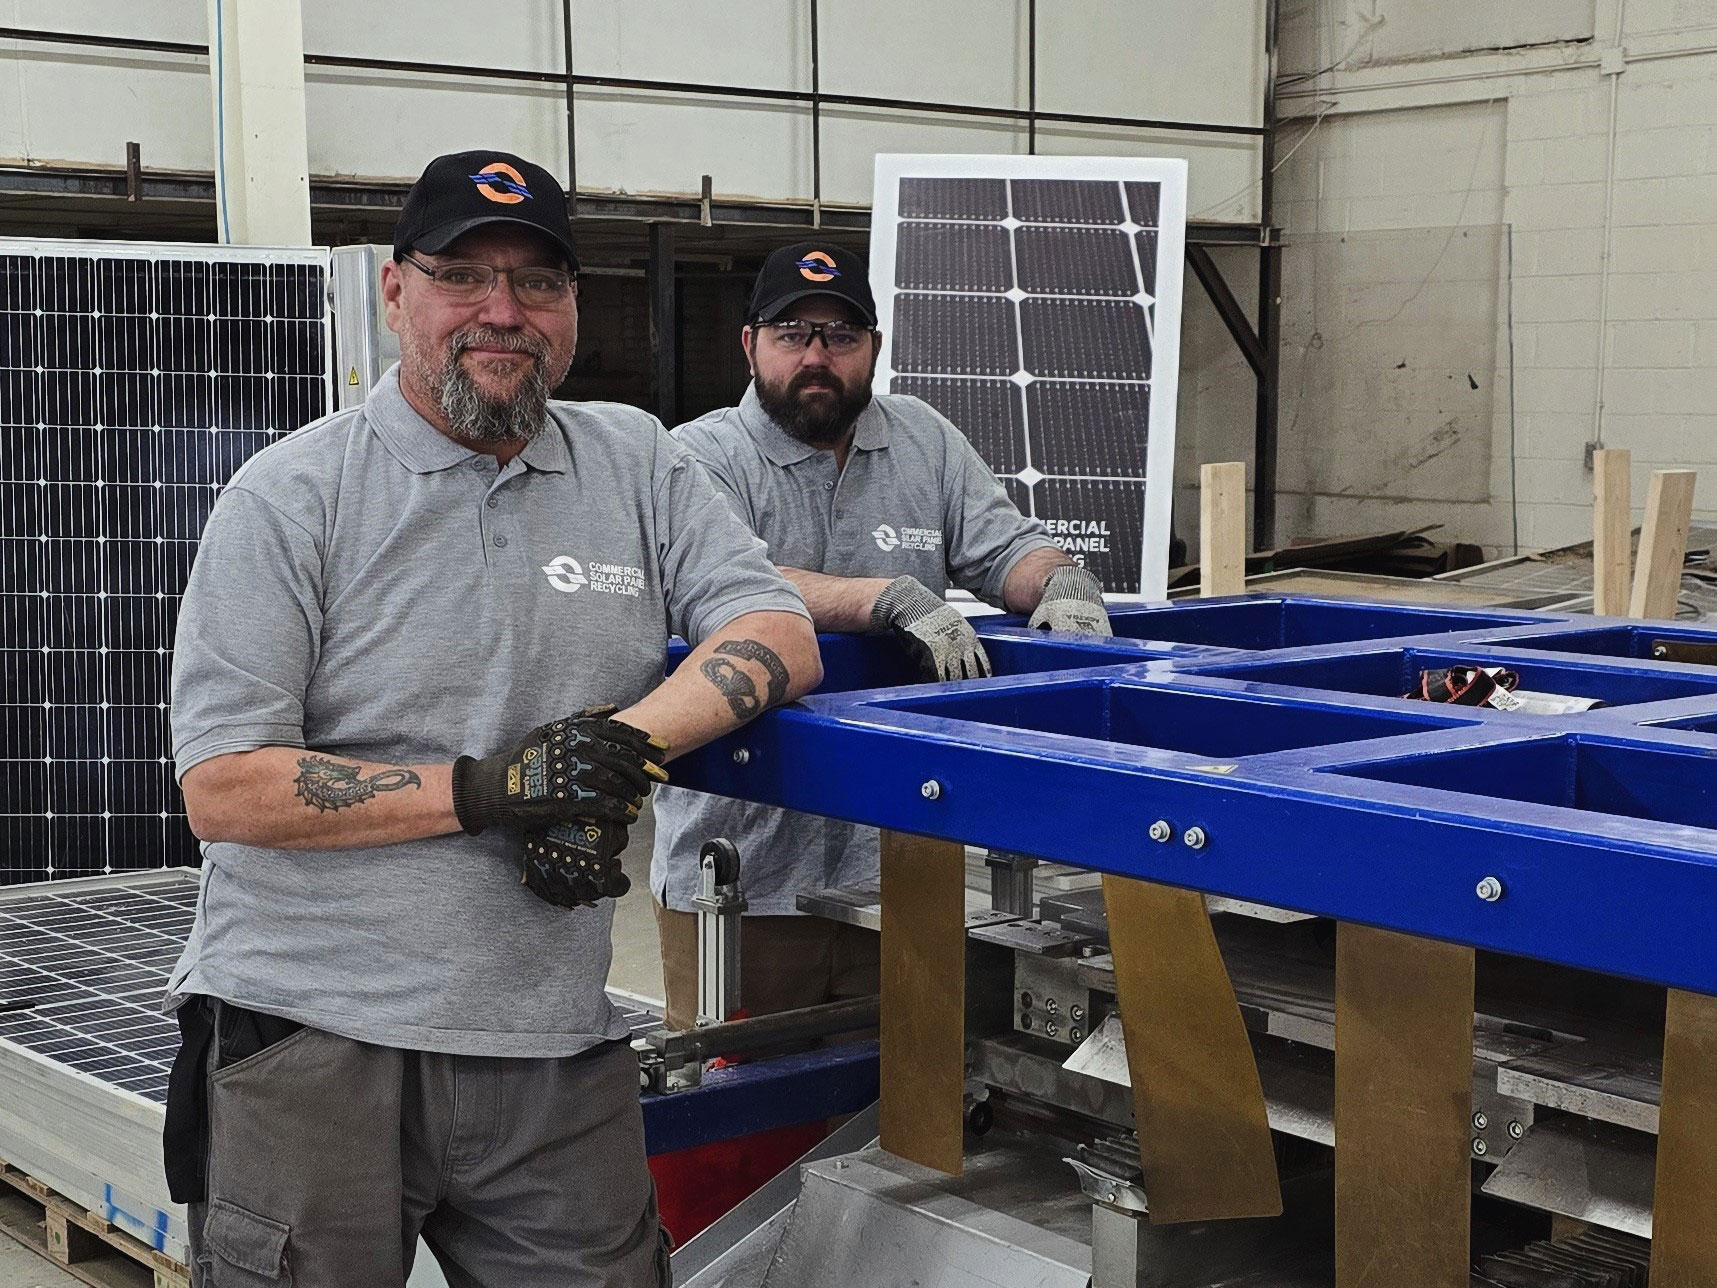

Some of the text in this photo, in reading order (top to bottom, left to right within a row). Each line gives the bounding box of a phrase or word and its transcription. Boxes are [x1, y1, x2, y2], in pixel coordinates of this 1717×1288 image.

[589, 571, 622, 585] SOLAR
[590, 581, 639, 598] RECYCLING
[525, 757, 543, 798] safe
